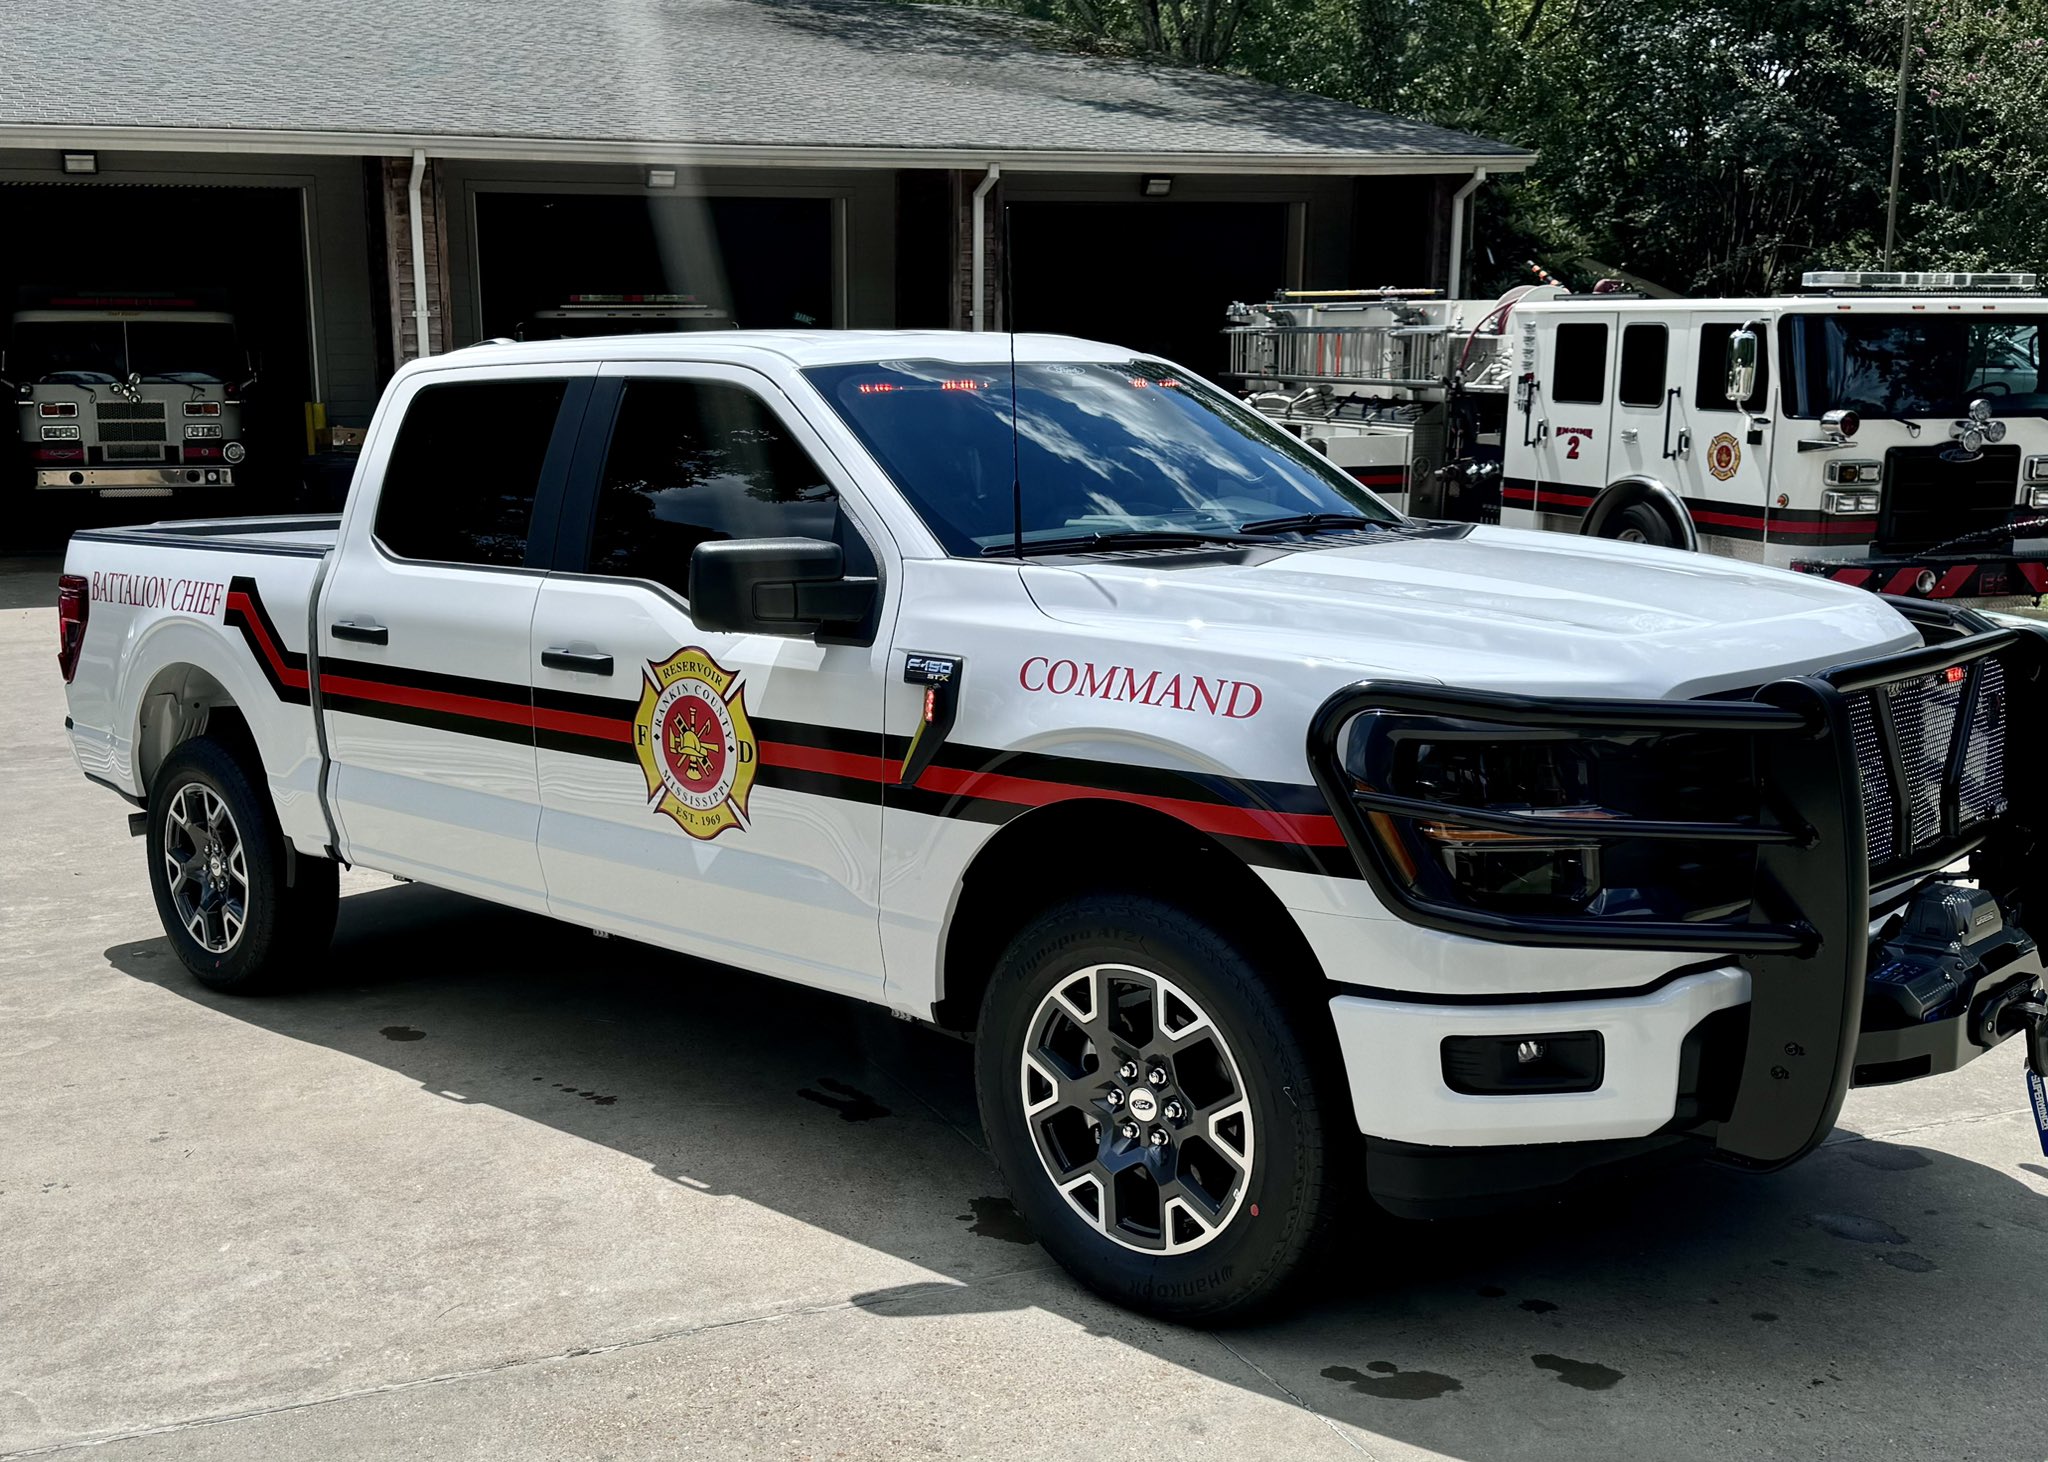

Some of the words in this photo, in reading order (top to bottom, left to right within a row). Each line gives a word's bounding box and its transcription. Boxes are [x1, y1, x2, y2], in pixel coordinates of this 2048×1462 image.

[1566, 435, 1580, 460] 2
[91, 571, 172, 609] BATTALION
[171, 578, 224, 616] CHIEF
[662, 661, 723, 687] RESERVOIR
[906, 658, 953, 674] F-150
[927, 673, 949, 682] STX
[1019, 656, 1263, 719] COMMAND
[655, 683, 690, 728] RANKIN
[694, 684, 733, 740] COUNTY
[637, 724, 648, 746] F
[738, 740, 753, 764] D
[662, 769, 730, 807] MISSISSIPPI
[676, 807, 699, 825] EST.
[701, 813, 721, 826] 1969
[1133, 1100, 1151, 1110] Ford
